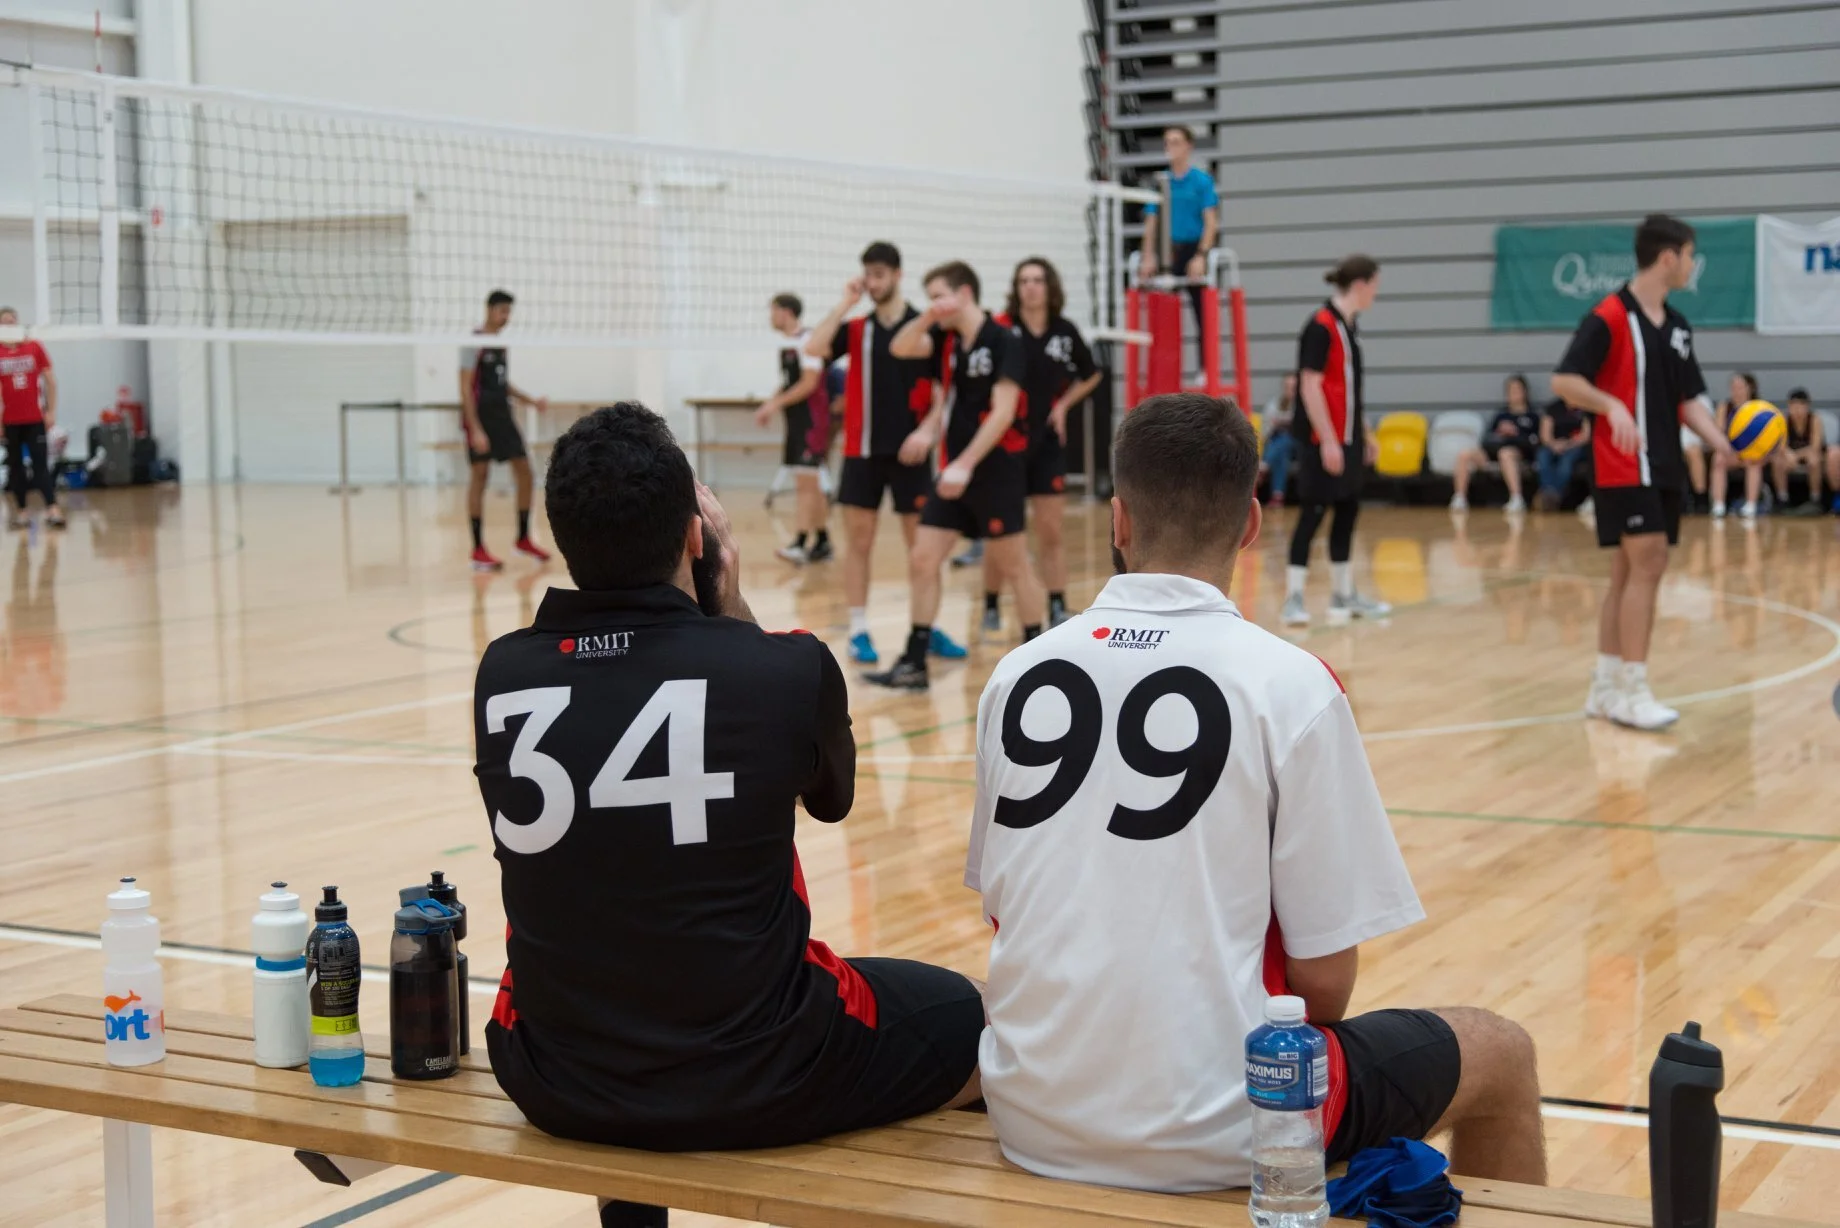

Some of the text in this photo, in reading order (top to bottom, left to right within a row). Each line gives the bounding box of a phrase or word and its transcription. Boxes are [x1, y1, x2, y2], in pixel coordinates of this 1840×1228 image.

[577, 631, 634, 652] RMIT
[1109, 628, 1170, 642] RMIT
[576, 648, 629, 659] UNIVERSITY
[1108, 641, 1159, 650] UNIVERSITY
[994, 658, 1231, 841] 99
[486, 679, 735, 854] 34
